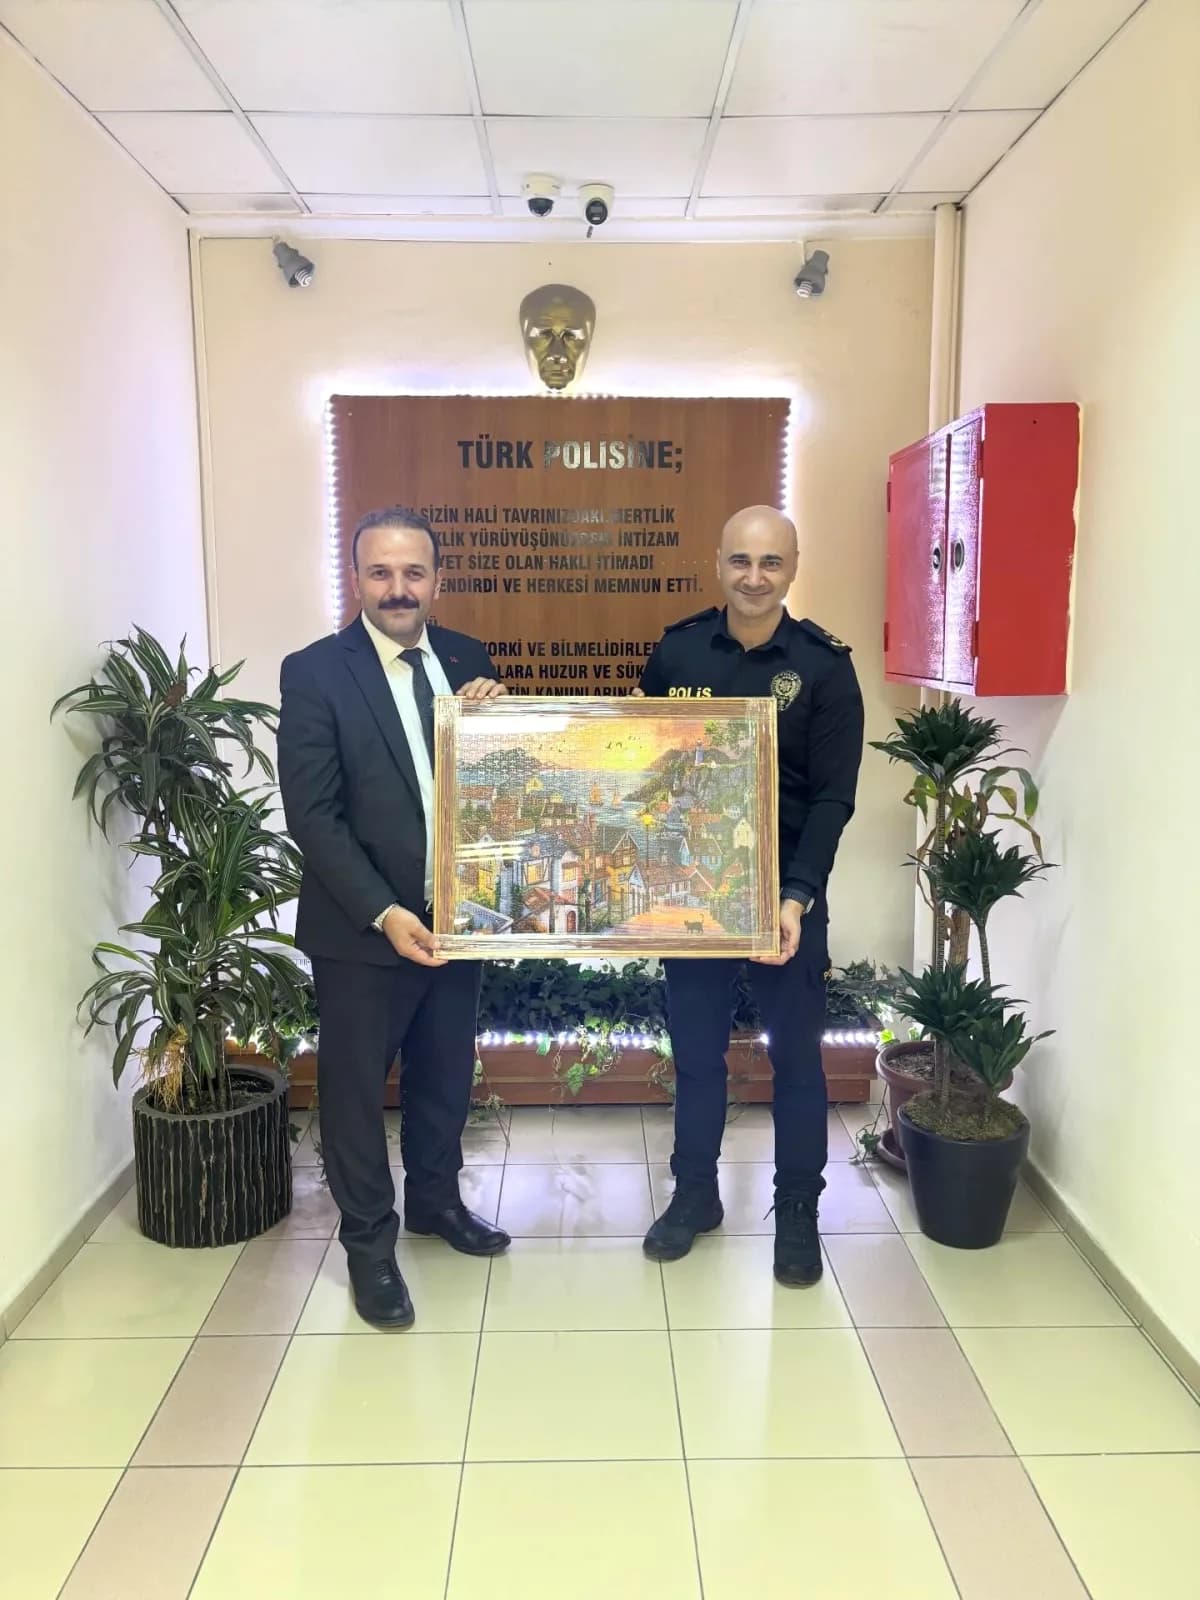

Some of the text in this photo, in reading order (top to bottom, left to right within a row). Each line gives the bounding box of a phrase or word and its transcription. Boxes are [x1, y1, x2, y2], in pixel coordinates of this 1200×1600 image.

[457, 434, 534, 469] TÜRK
[464, 504, 498, 523] HALİ
[618, 527, 680, 547] İNTİZAM
[468, 551, 500, 570] SİZE
[505, 554, 544, 570] OLAN
[503, 578, 521, 593] VE
[527, 574, 589, 593] HERKESİ
[594, 578, 661, 593] MEMNUN
[527, 642, 546, 657] VE
[539, 664, 588, 679] HUZUR
[593, 664, 611, 679] VE
